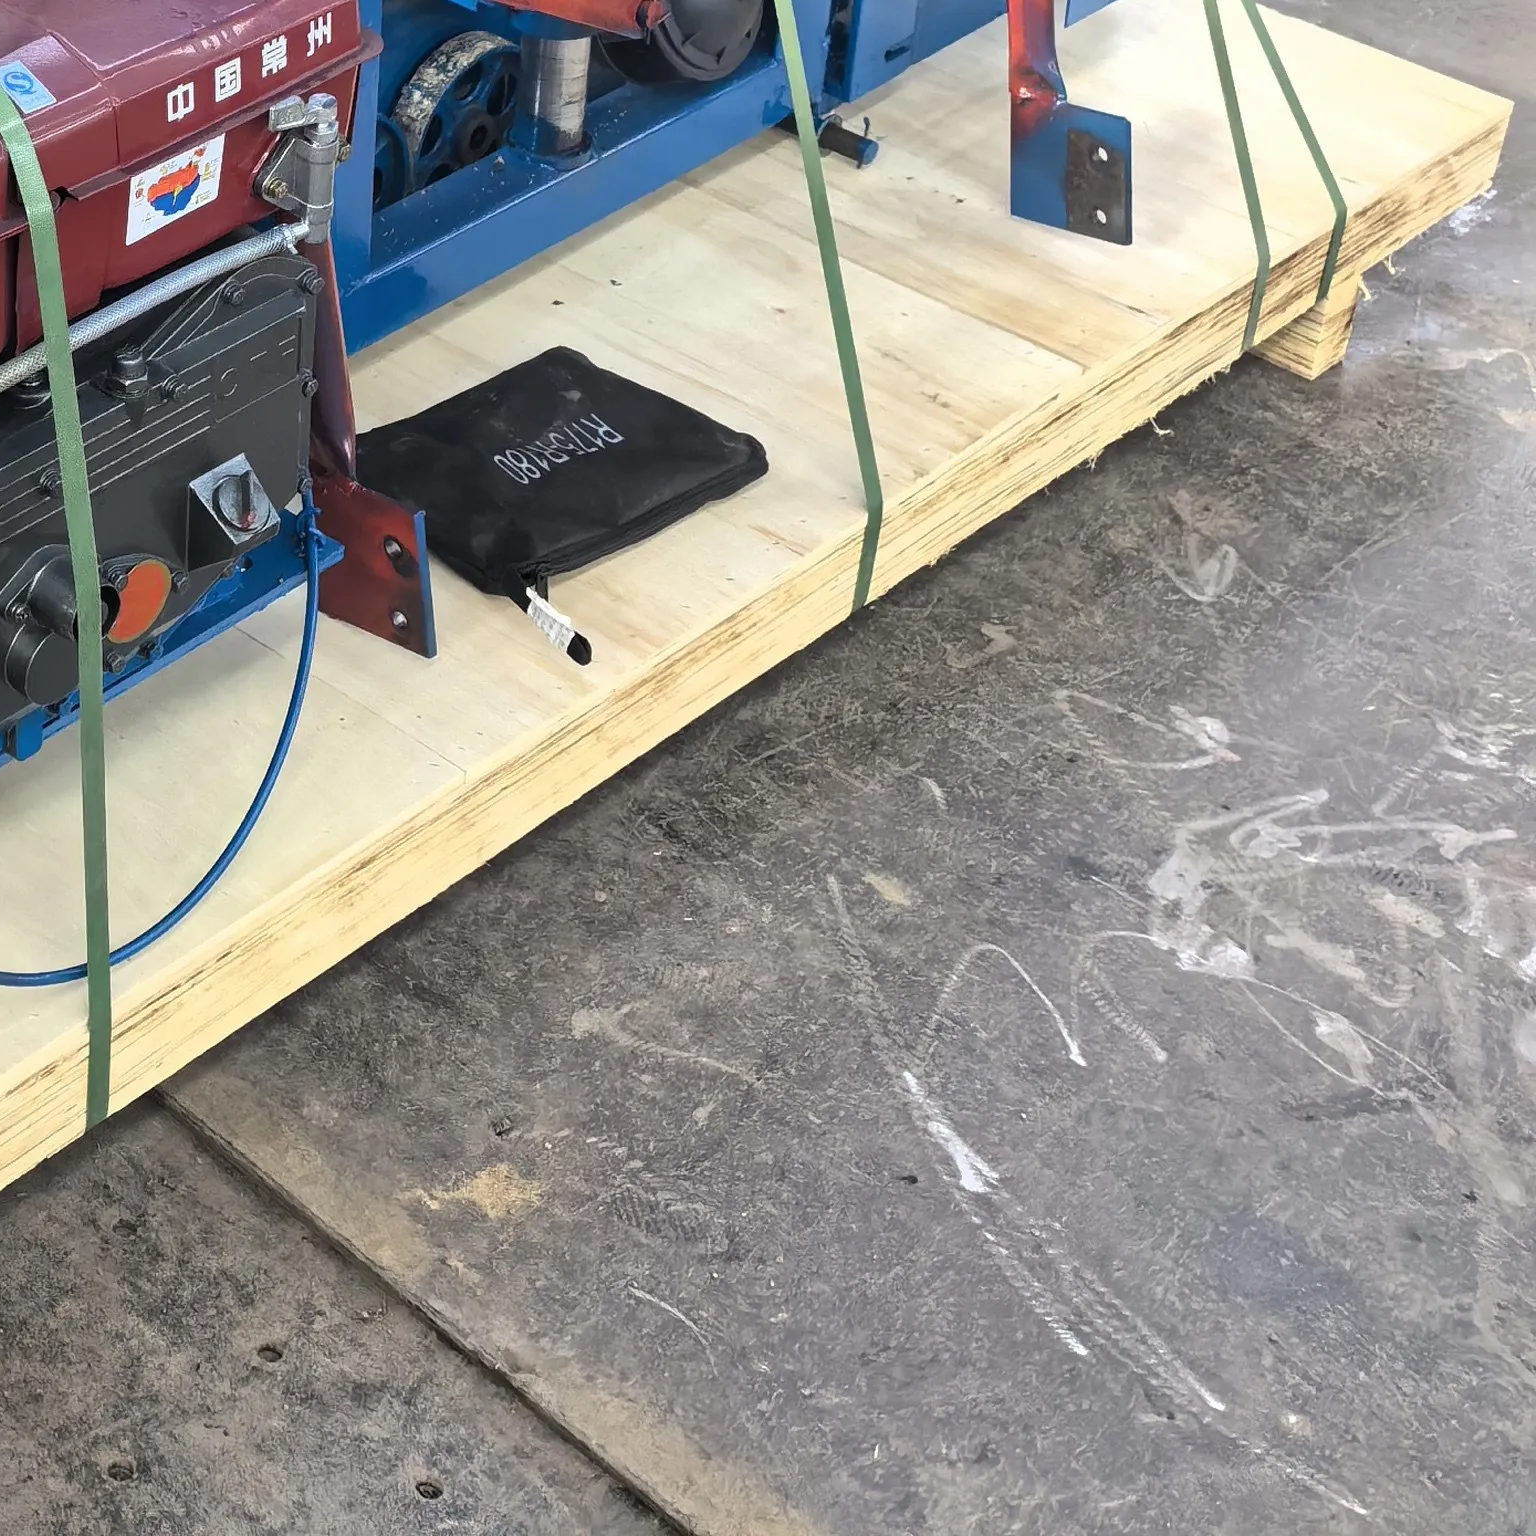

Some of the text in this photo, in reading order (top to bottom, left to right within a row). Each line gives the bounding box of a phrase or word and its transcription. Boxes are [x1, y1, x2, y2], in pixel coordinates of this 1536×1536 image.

[167, 12, 332, 123] 中国常州
[493, 412, 625, 484] R175-R180
